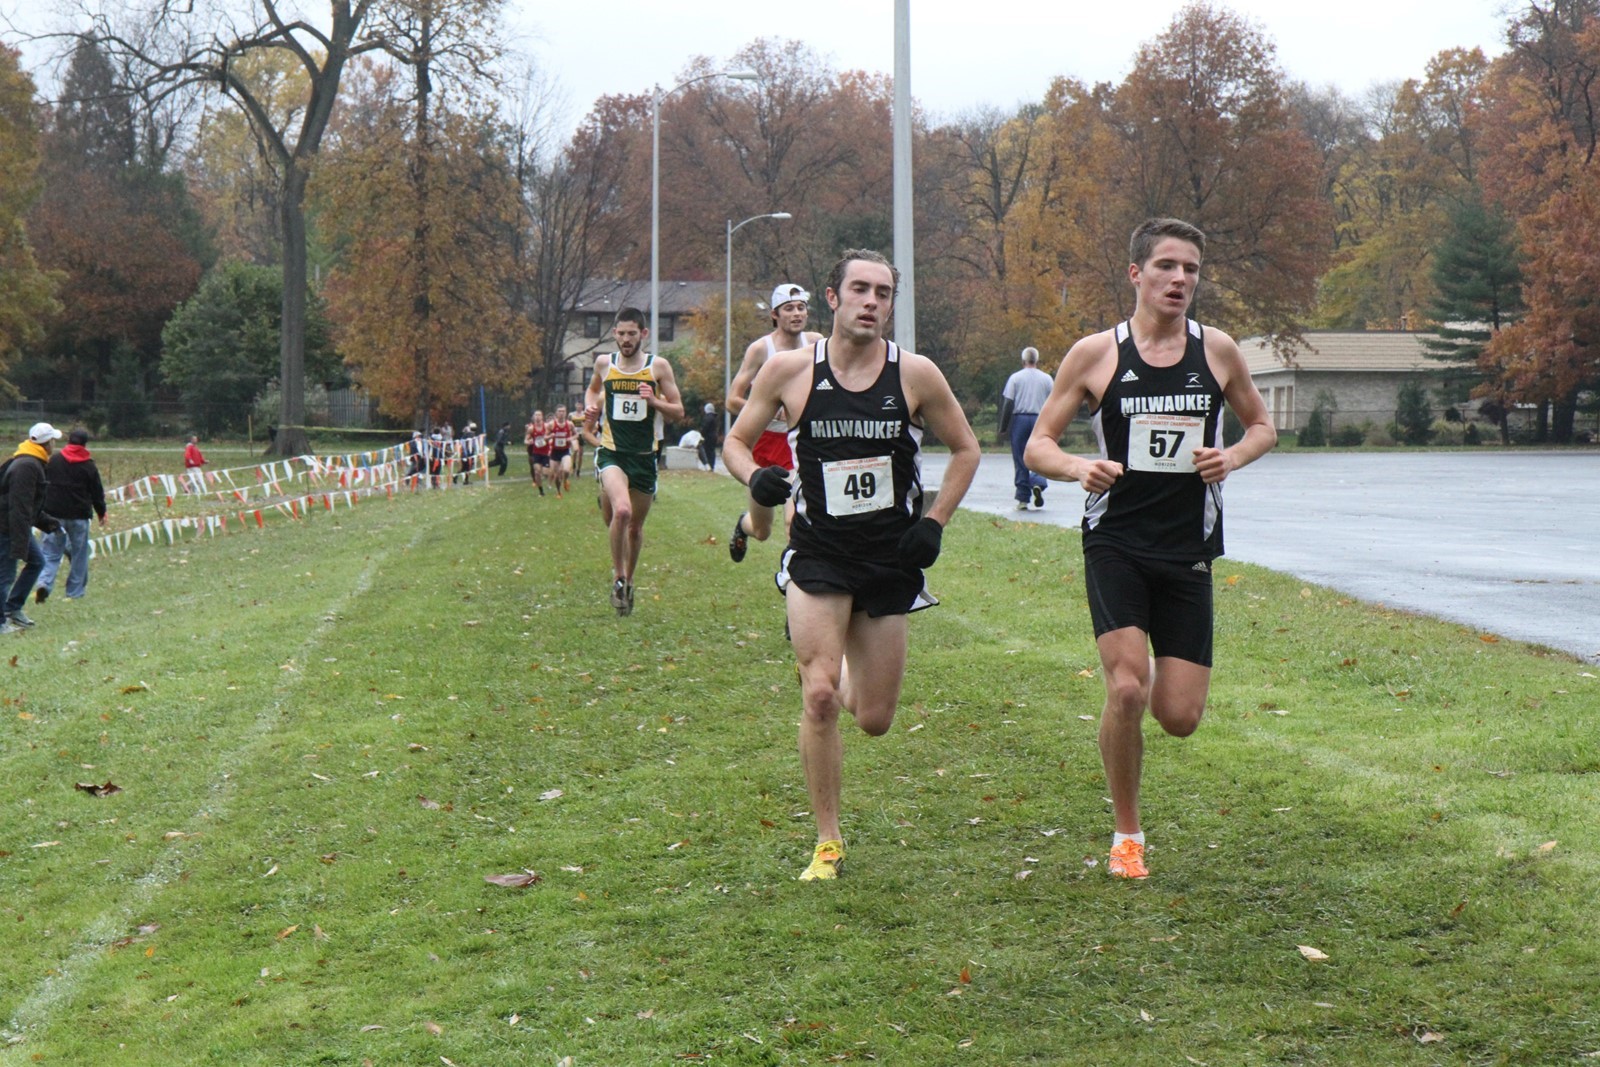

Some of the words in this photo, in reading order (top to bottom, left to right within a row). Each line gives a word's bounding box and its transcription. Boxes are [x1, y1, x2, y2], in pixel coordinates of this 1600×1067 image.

[622, 401, 638, 414] 64
[1120, 394, 1211, 413] MILWAUKEE
[810, 420, 902, 439] MILWAUKEE
[1149, 429, 1185, 458] 57
[844, 472, 876, 500] 49
